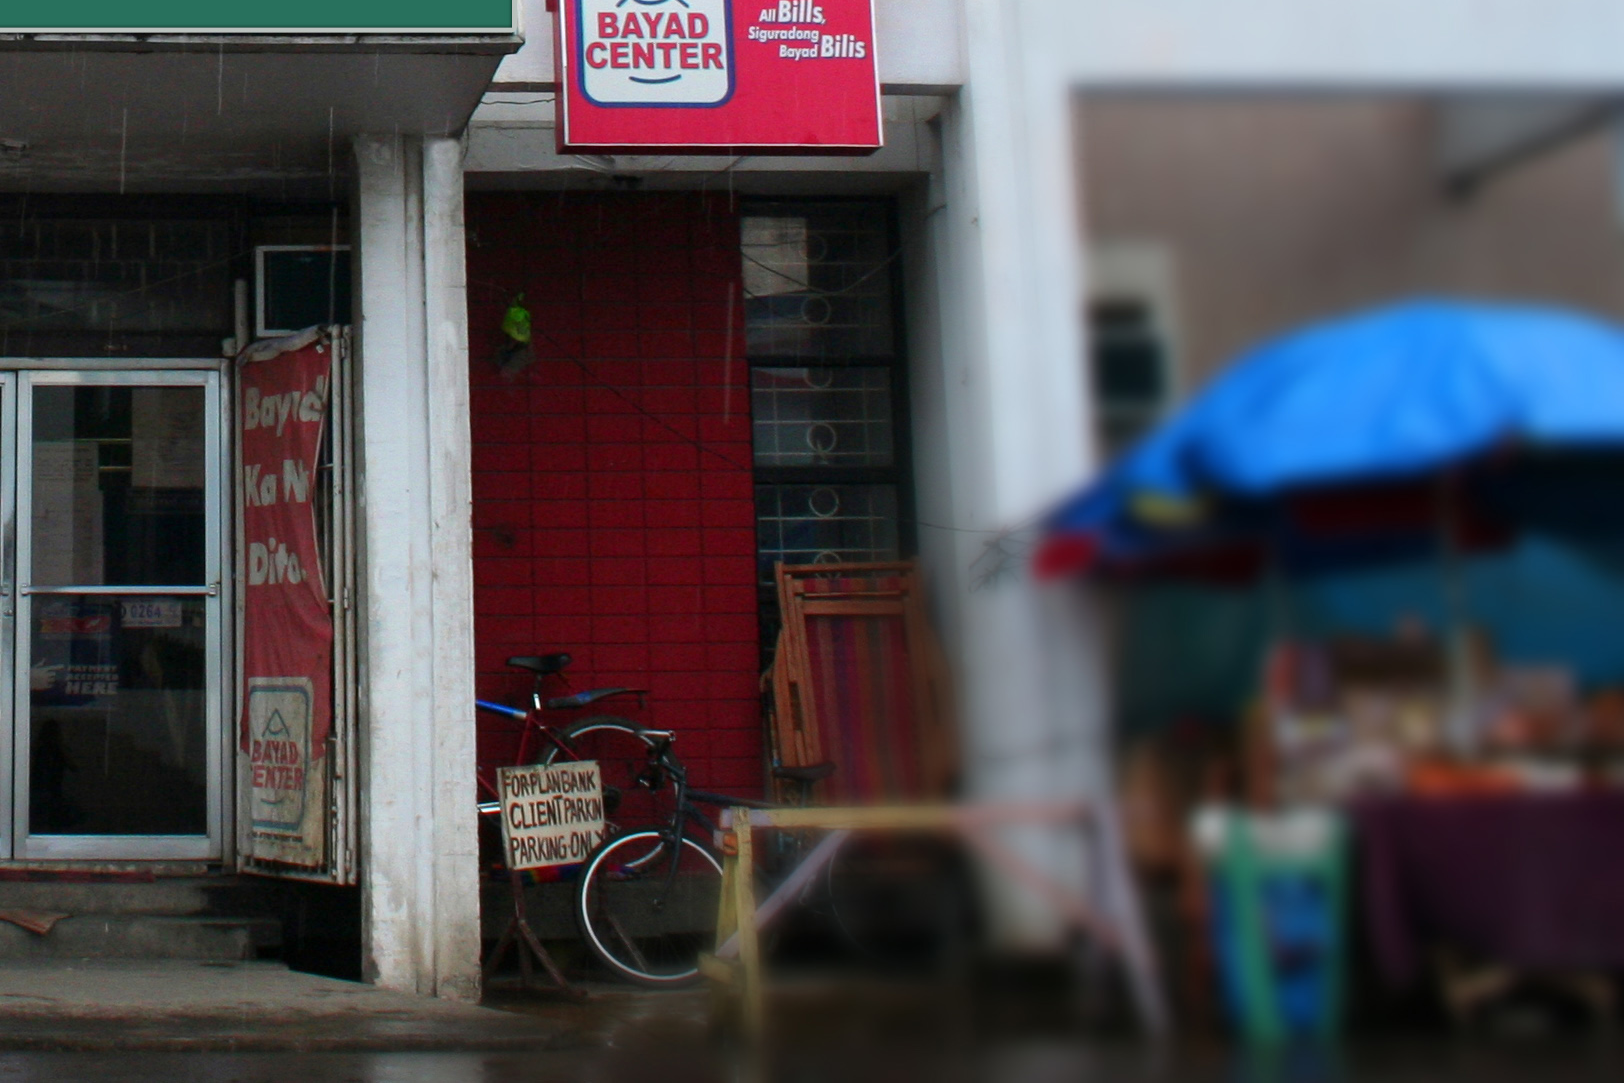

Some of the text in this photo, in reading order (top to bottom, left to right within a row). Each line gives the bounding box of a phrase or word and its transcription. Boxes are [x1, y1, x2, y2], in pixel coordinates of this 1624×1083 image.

[596, 11, 710, 39] BAYAD
[759, 0, 827, 25] All Bills,
[747, 25, 820, 44] Siguradong
[779, 34, 866, 61] Bayad Bilis
[584, 41, 725, 70] CENTER
[244, 463, 277, 507] Ka
[251, 740, 299, 765] BAYAD
[251, 764, 304, 790] ENTER
[510, 794, 563, 829] CLIENT
